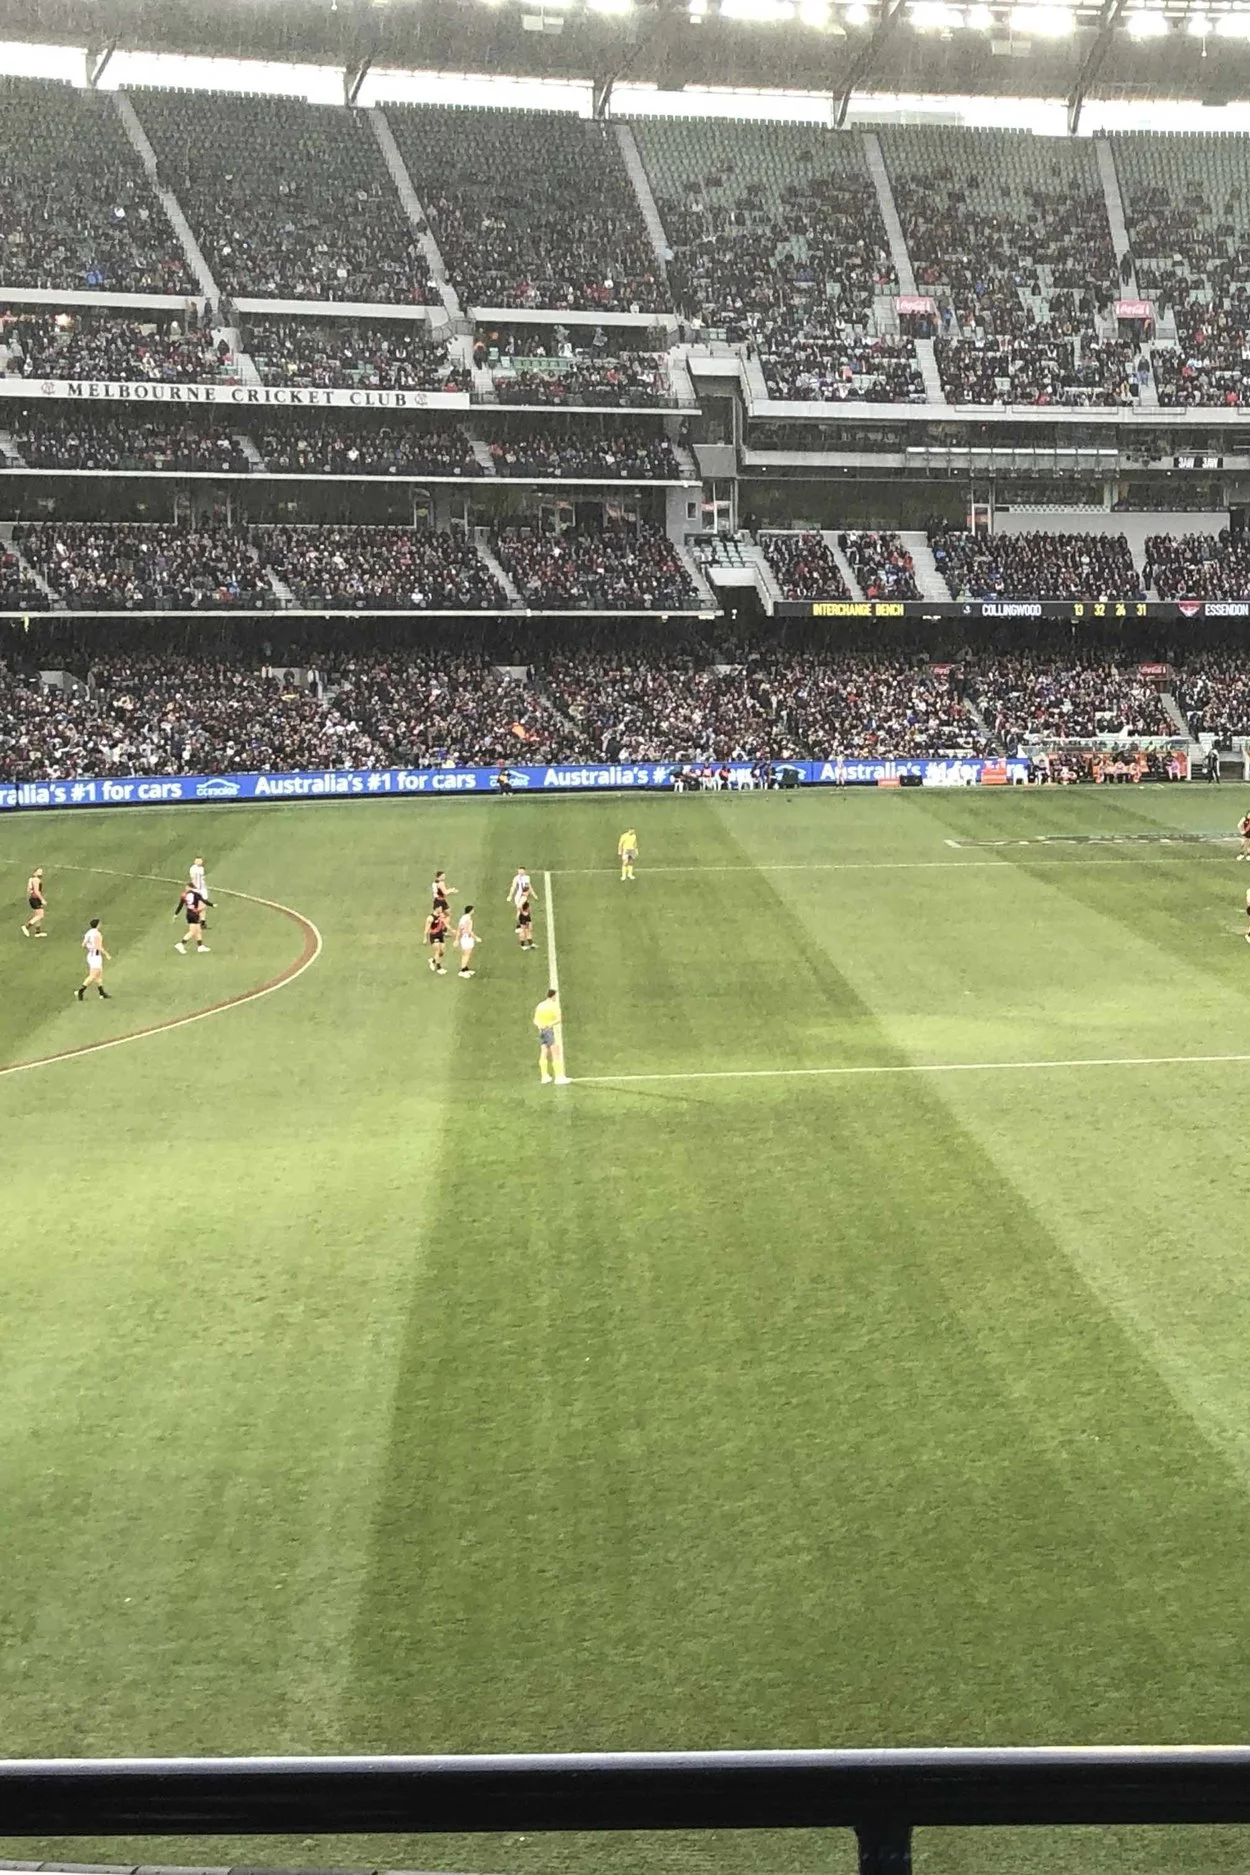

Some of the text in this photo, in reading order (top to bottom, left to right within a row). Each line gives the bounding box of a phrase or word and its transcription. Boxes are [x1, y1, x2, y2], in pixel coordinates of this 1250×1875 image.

[67, 382, 216, 401] MELBOURNE
[231, 388, 335, 405] CRICKET
[349, 391, 407, 407] CLUB
[813, 603, 904, 616] INTERCHANGE BENCH
[982, 603, 1041, 616] COLLINGWOOD
[1205, 603, 1249, 616] ESSENDON
[255, 771, 476, 795] Australia's #1 for cars
[544, 767, 649, 786] Australia's
[71, 782, 96, 802] #1
[102, 781, 133, 800] for
[138, 783, 182, 799] cars
